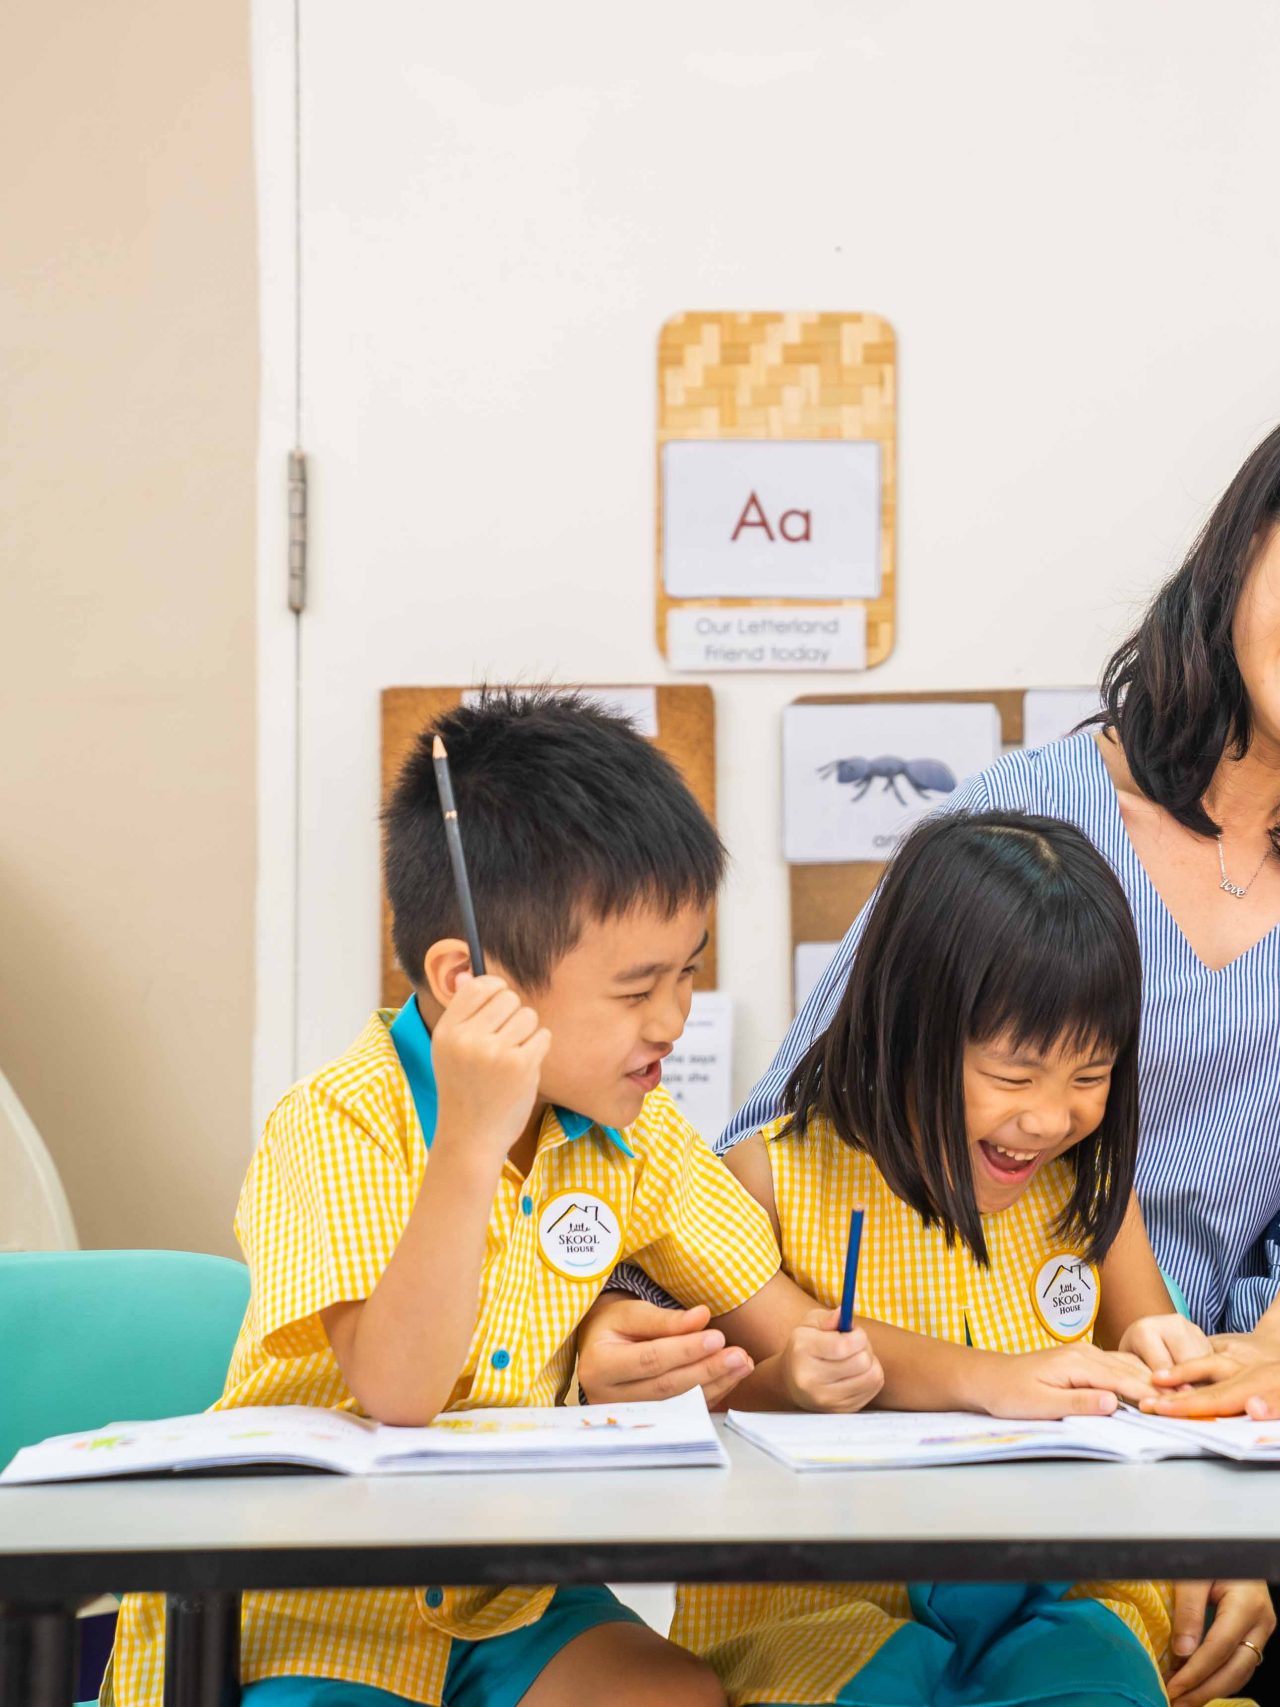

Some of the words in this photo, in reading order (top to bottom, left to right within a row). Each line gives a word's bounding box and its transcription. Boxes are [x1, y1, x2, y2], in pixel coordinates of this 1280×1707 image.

[730, 490, 811, 543] Aa
[695, 617, 732, 635] Our
[738, 617, 840, 635] Letterland
[704, 644, 765, 662] Friend
[770, 644, 830, 663] today
[872, 834, 900, 848] an
[558, 1234, 600, 1245] SKOOL
[566, 1245, 595, 1253] HOUSE
[1052, 1293, 1085, 1308] SKOOL
[1059, 1304, 1081, 1315] HOUSE
